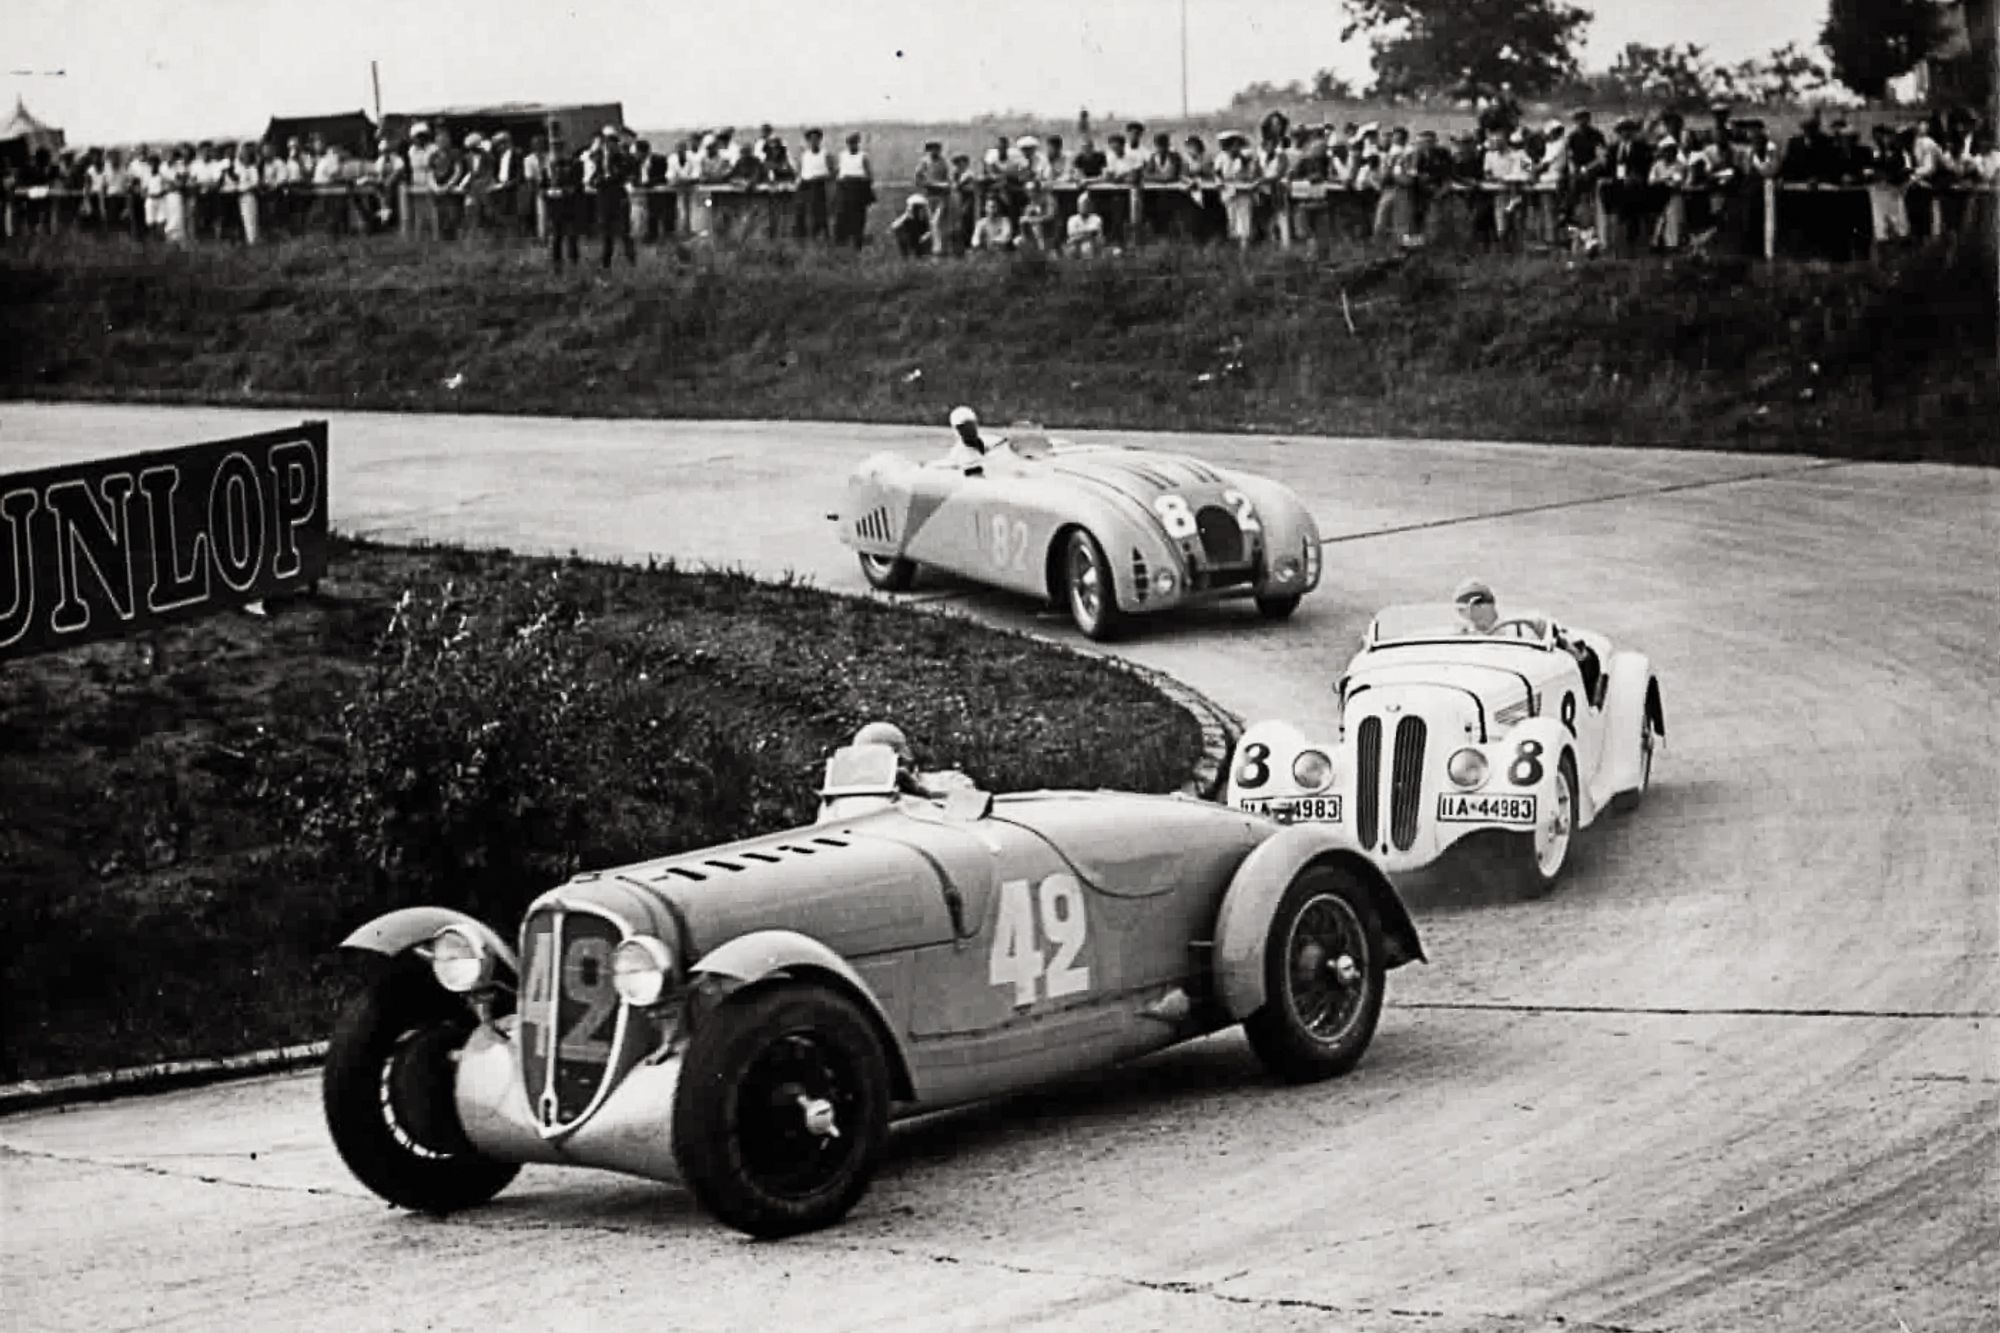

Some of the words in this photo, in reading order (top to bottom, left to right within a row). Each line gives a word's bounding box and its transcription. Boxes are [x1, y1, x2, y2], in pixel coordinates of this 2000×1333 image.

[1155, 494, 1197, 539] 8
[992, 514, 1028, 571] 82
[1508, 739, 1543, 787] 8
